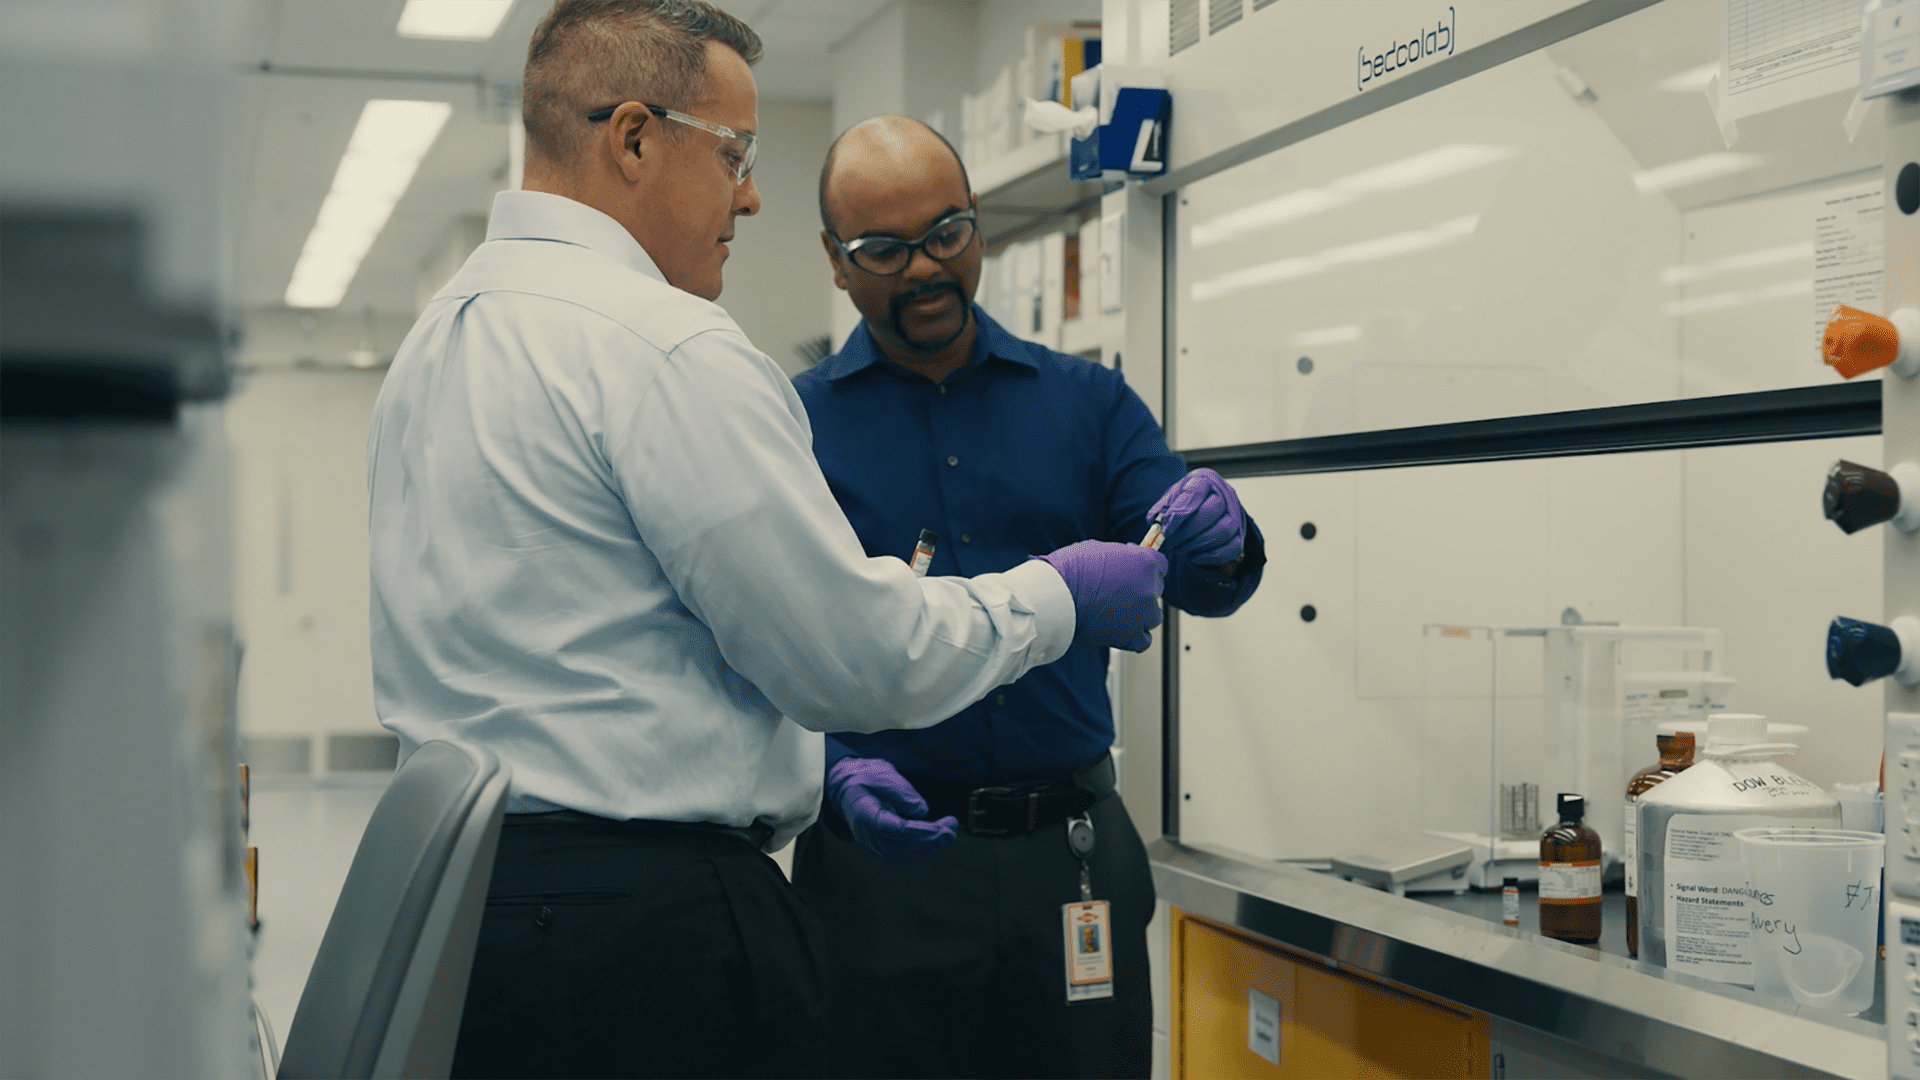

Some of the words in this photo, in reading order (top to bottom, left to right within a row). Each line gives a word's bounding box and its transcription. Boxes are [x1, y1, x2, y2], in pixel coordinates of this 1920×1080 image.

[1732, 775, 1767, 793] DOW
[1770, 774, 1818, 790] BLEN
[1676, 883, 1696, 892] Signal
[1676, 895, 1700, 904] Hazard
[1751, 911, 1802, 956] Avery
